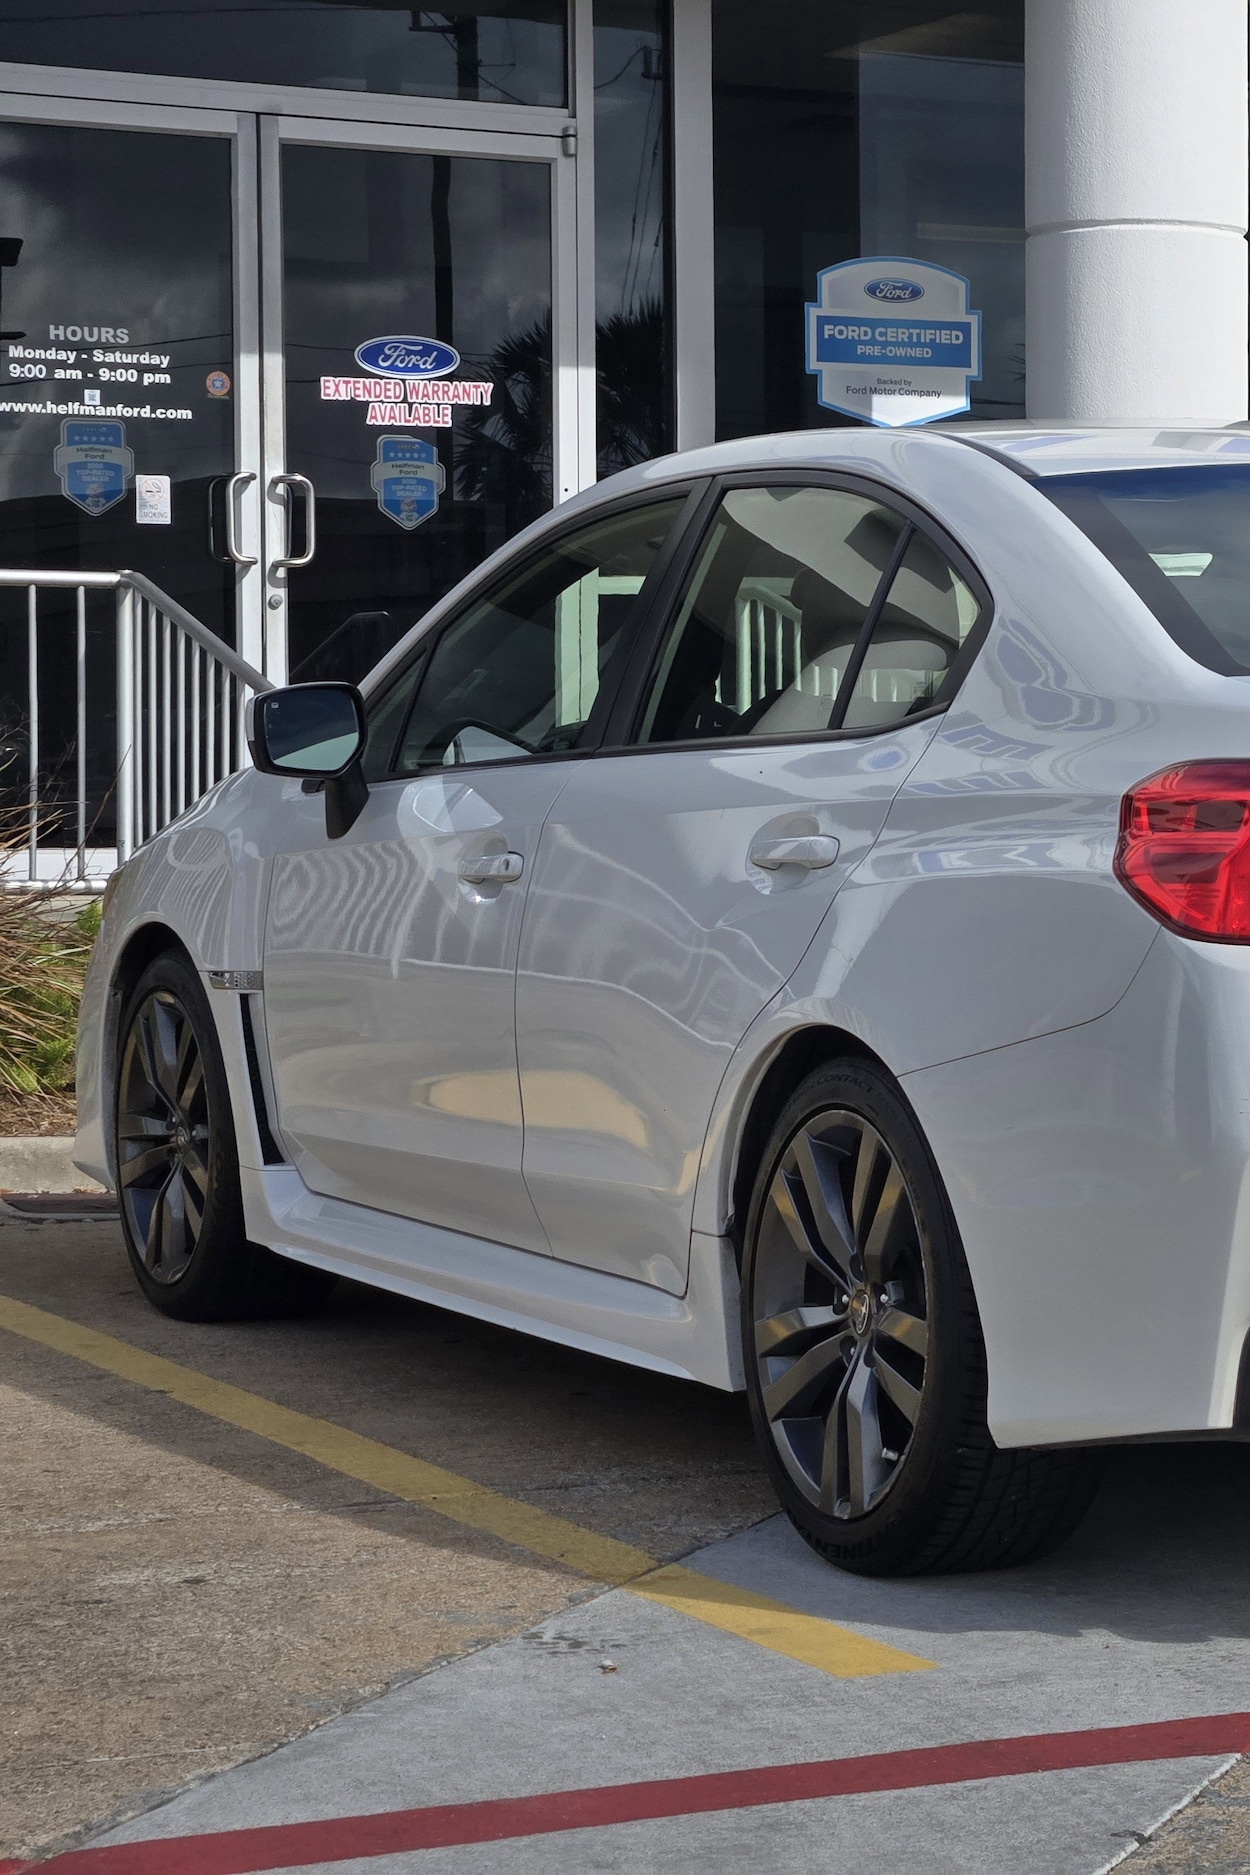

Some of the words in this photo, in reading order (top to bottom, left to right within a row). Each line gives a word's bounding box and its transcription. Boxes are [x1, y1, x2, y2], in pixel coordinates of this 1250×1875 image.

[876, 282, 912, 299] Ford
[49, 325, 130, 344] HOURS
[824, 324, 872, 340] FORD
[875, 328, 964, 345] CERTIFIED
[8, 345, 77, 364] Monday
[93, 349, 170, 367] Saturday
[377, 342, 438, 370] Ford
[857, 345, 932, 358] PRE-OWNED
[9, 364, 46, 379] 9:00
[54, 368, 82, 380] am
[99, 368, 137, 382] 9:00
[143, 371, 171, 386] pm
[877, 378, 903, 386] Backed
[904, 379, 912, 387] by
[321, 377, 404, 400] EXTENDED
[407, 381, 494, 405] WARRANTY
[846, 386, 867, 395] Ford
[869, 387, 896, 396] Motor
[898, 388, 942, 398] Company
[0, 400, 193, 420] www.helfmanford.com
[366, 403, 452, 427] AVAILABLE
[140, 511, 168, 519] SMOKING
